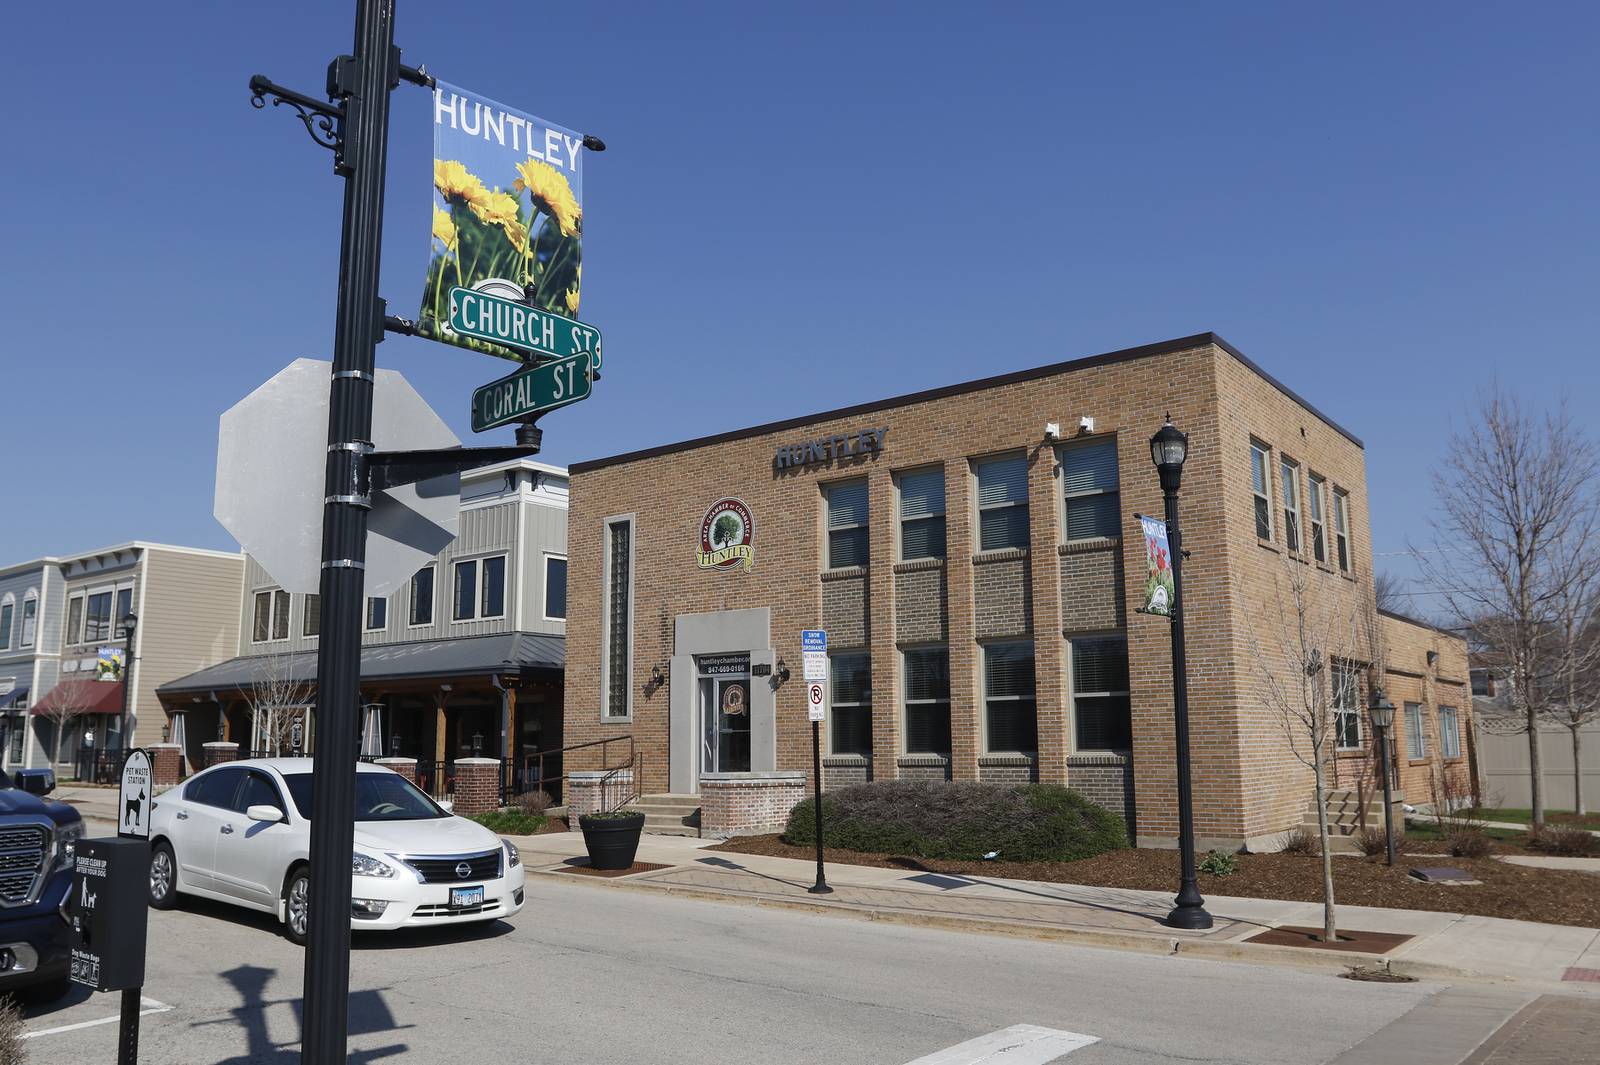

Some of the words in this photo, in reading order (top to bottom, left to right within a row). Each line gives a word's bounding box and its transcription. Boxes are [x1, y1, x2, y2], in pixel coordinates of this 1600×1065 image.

[434, 87, 582, 172] HUNTLEY
[462, 295, 555, 350] CHURCH
[571, 327, 593, 353] ST
[484, 375, 536, 420] CORAL
[553, 361, 577, 400] ST
[776, 425, 889, 468] HUNTLEY
[707, 503, 729, 523] CHAMBER
[735, 505, 750, 537] COMMERCE
[701, 546, 751, 564] HUNTLEY
[126, 767, 134, 775] PET
[135, 767, 149, 776] WASTE
[127, 776, 146, 785] STATION
[76, 856, 89, 865] PLEASE
[98, 869, 107, 877] DOG
